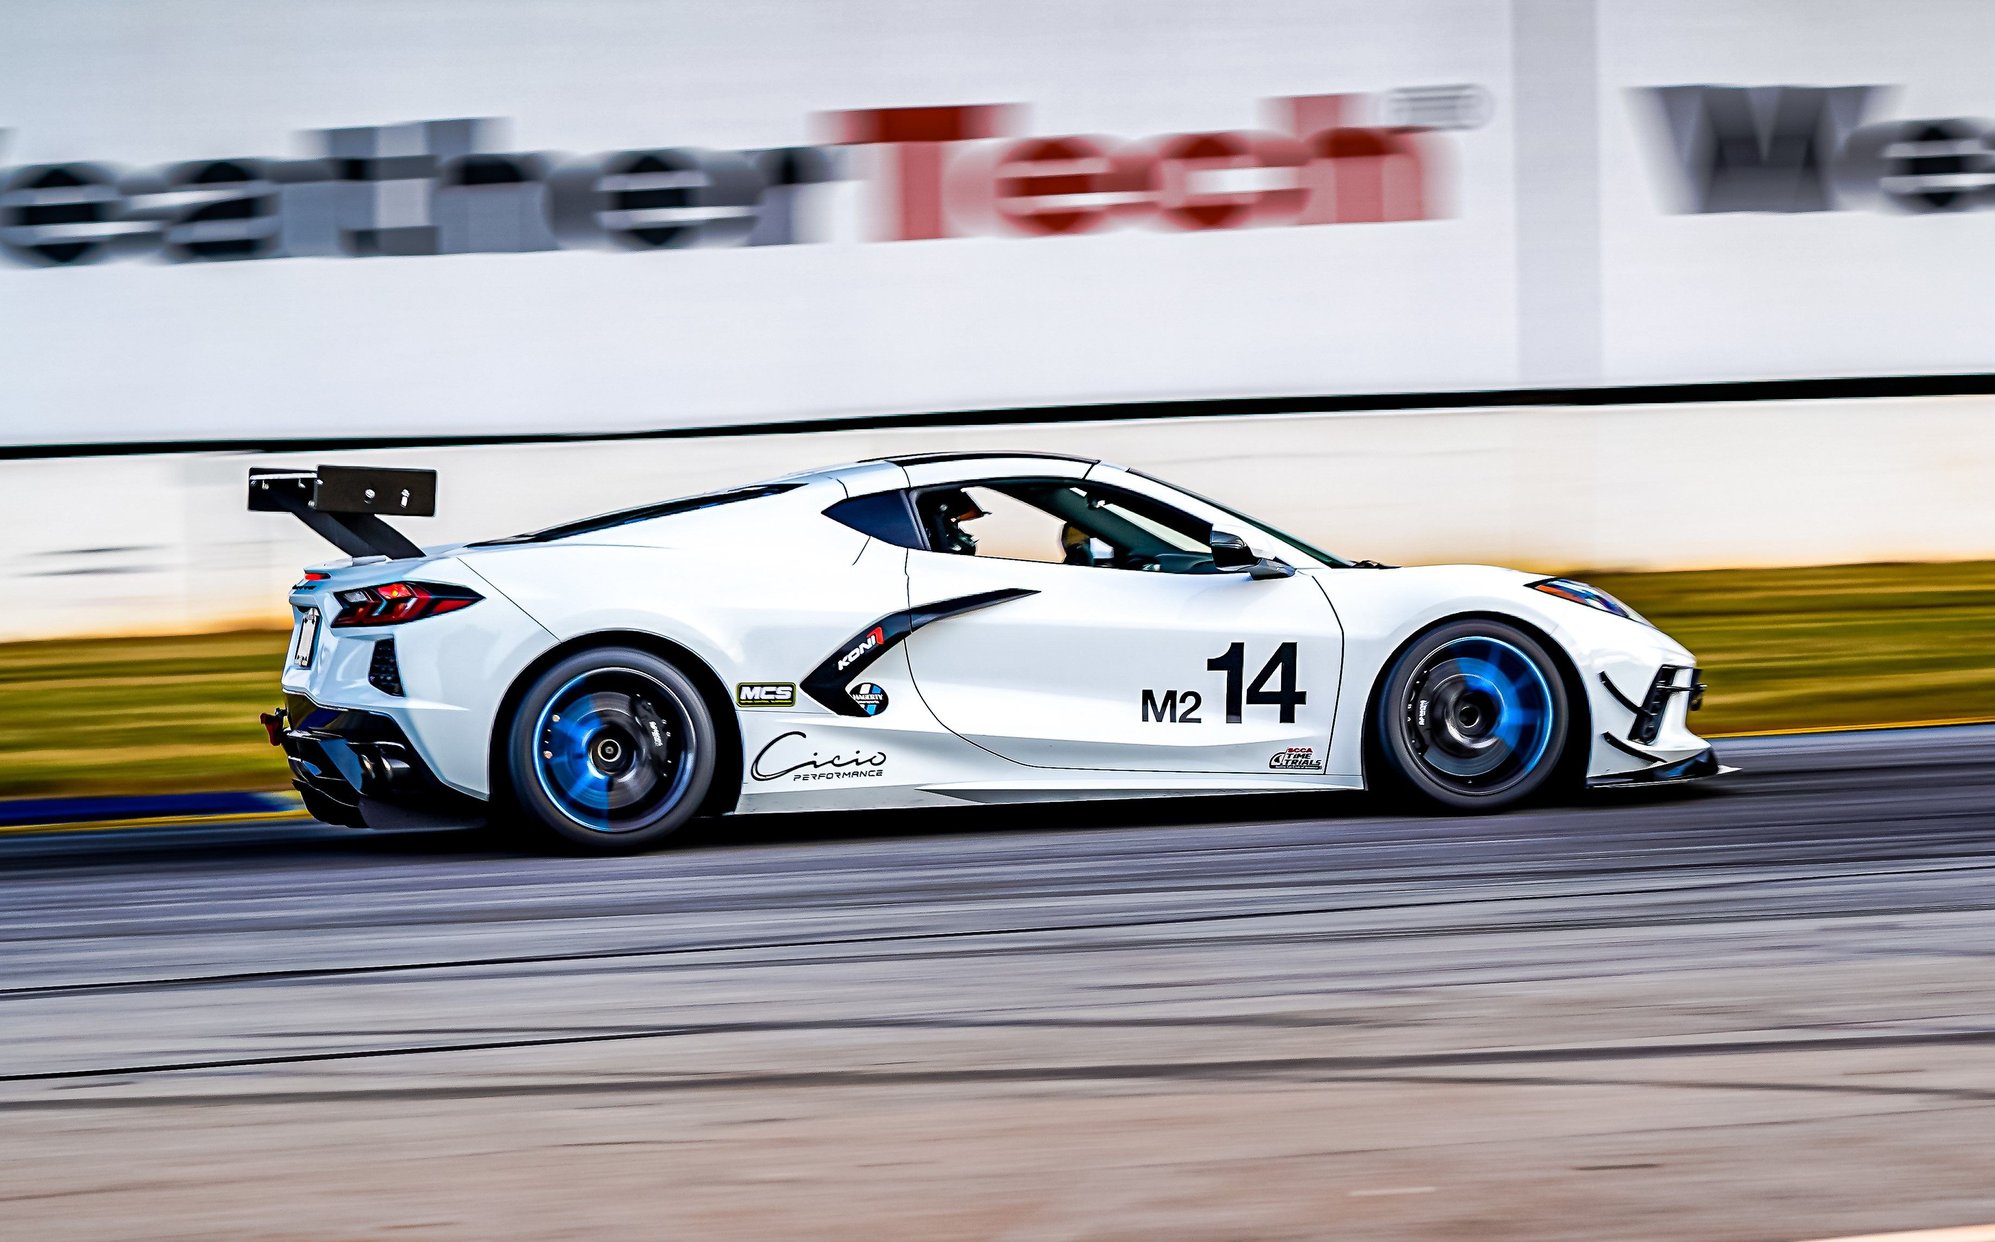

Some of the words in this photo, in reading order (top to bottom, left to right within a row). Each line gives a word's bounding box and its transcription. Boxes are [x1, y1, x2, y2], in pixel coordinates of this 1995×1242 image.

[0, 95, 1456, 268] eatherTech
[838, 634, 876, 671] KONI
[740, 686, 793, 700] MCS
[1141, 689, 1202, 723] M2
[1206, 641, 1307, 724] 14
[750, 730, 888, 782] Cicio
[793, 769, 885, 782] PERFORMANCE
